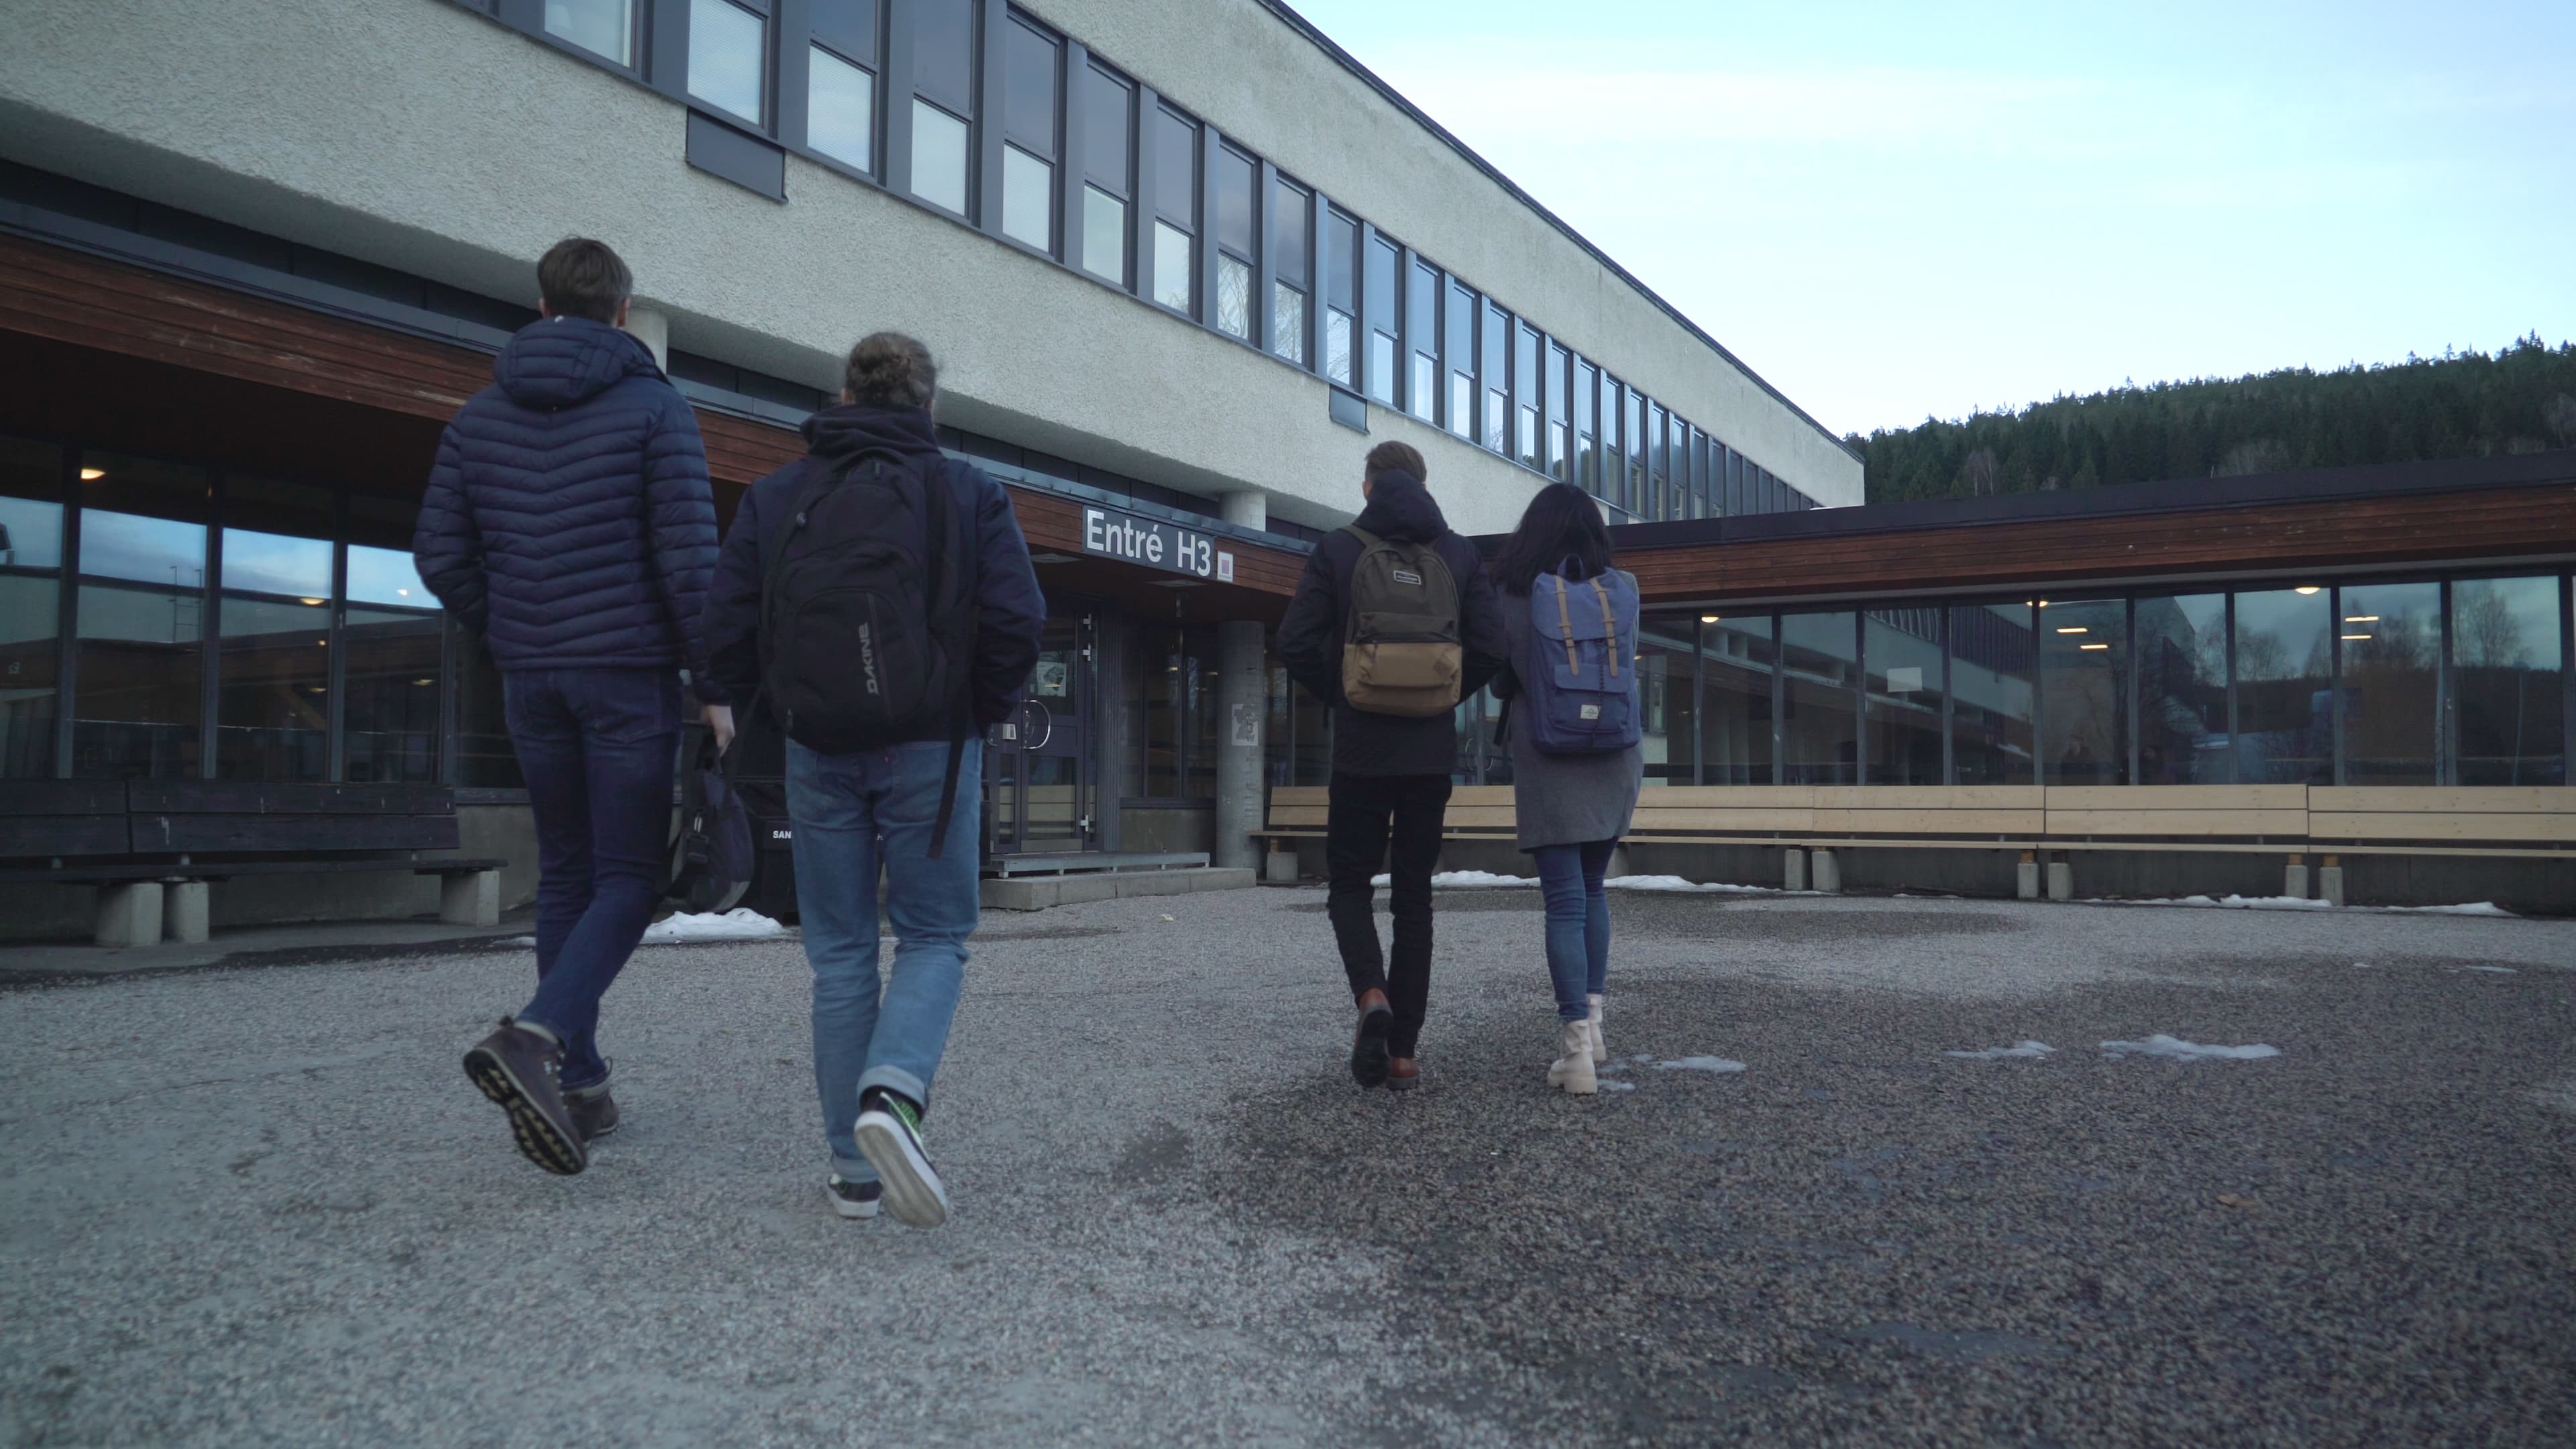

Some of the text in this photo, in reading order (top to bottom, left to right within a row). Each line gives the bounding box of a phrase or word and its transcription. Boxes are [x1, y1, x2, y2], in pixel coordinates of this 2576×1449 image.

[1087, 509, 1211, 577] Entré H3
[859, 622, 879, 695] DAKINE
